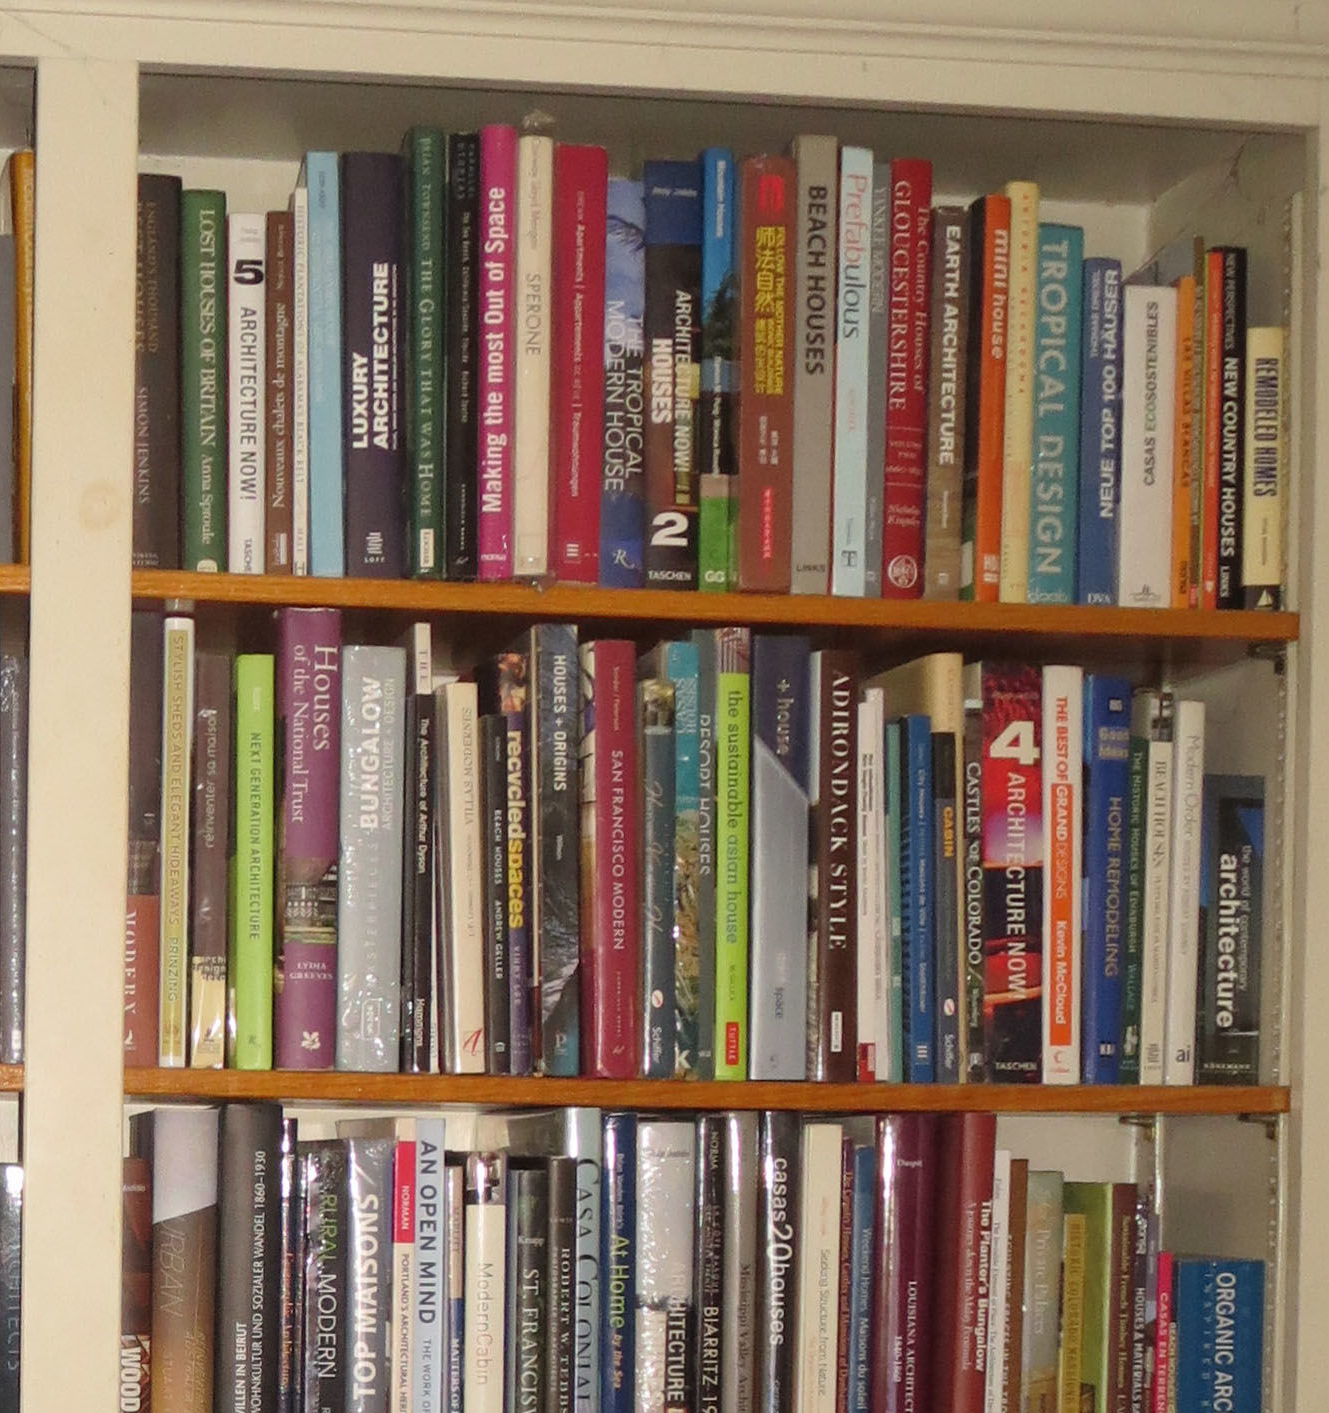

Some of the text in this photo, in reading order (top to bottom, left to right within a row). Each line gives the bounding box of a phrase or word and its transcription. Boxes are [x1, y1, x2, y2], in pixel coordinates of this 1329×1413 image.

[805, 186, 827, 374] BEACH HOUSES
[842, 174, 867, 338] Prefabulous
[200, 210, 215, 544] LOST HOUSES OF BRITAIN Anna Sproule
[234, 259, 264, 500] 5 ARCHITECTURE NOW!
[480, 187, 507, 512] Making the most Out of Space
[605, 301, 623, 490] MODERN HOUSE
[625, 317, 643, 478] THE TROPICAL
[652, 338, 672, 423] HOUSES
[674, 291, 690, 472] ARCHITECTURE NOW!
[939, 226, 960, 464] EARTH ARCHITECTURE
[1036, 241, 1068, 575] TROPICAL DESIGN
[652, 512, 688, 546] 2
[1221, 357, 1239, 556] NEW COUNTRY HOUSES
[291, 645, 308, 822] of the National Trust
[313, 645, 336, 750] Houses
[612, 750, 625, 949] SAN FRANCISCO MODERN
[726, 691, 742, 943] the sustainable asian house
[829, 670, 850, 949] ADIRONDACK STYLE
[990, 721, 1040, 998] 4 ARCHITECTURE NOW!
[1055, 697, 1068, 1023] THE BEST OF GRAND DESIGNS Kevin McCloud
[1217, 854, 1237, 1027] architecture
[420, 1142, 436, 1185] AN
[420, 1197, 437, 1251] OPEN
[352, 1195, 378, 1397] TOP MAISONS
[419, 1262, 435, 1323] MIND
[422, 1340, 432, 1356] THE
[522, 1269, 539, 1300] ST.
[702, 1307, 720, 1387] BIARRITZ
[1214, 1273, 1236, 1364] ORGANIC
[422, 1360, 432, 1396] WORK
[422, 1401, 431, 1413] OF
